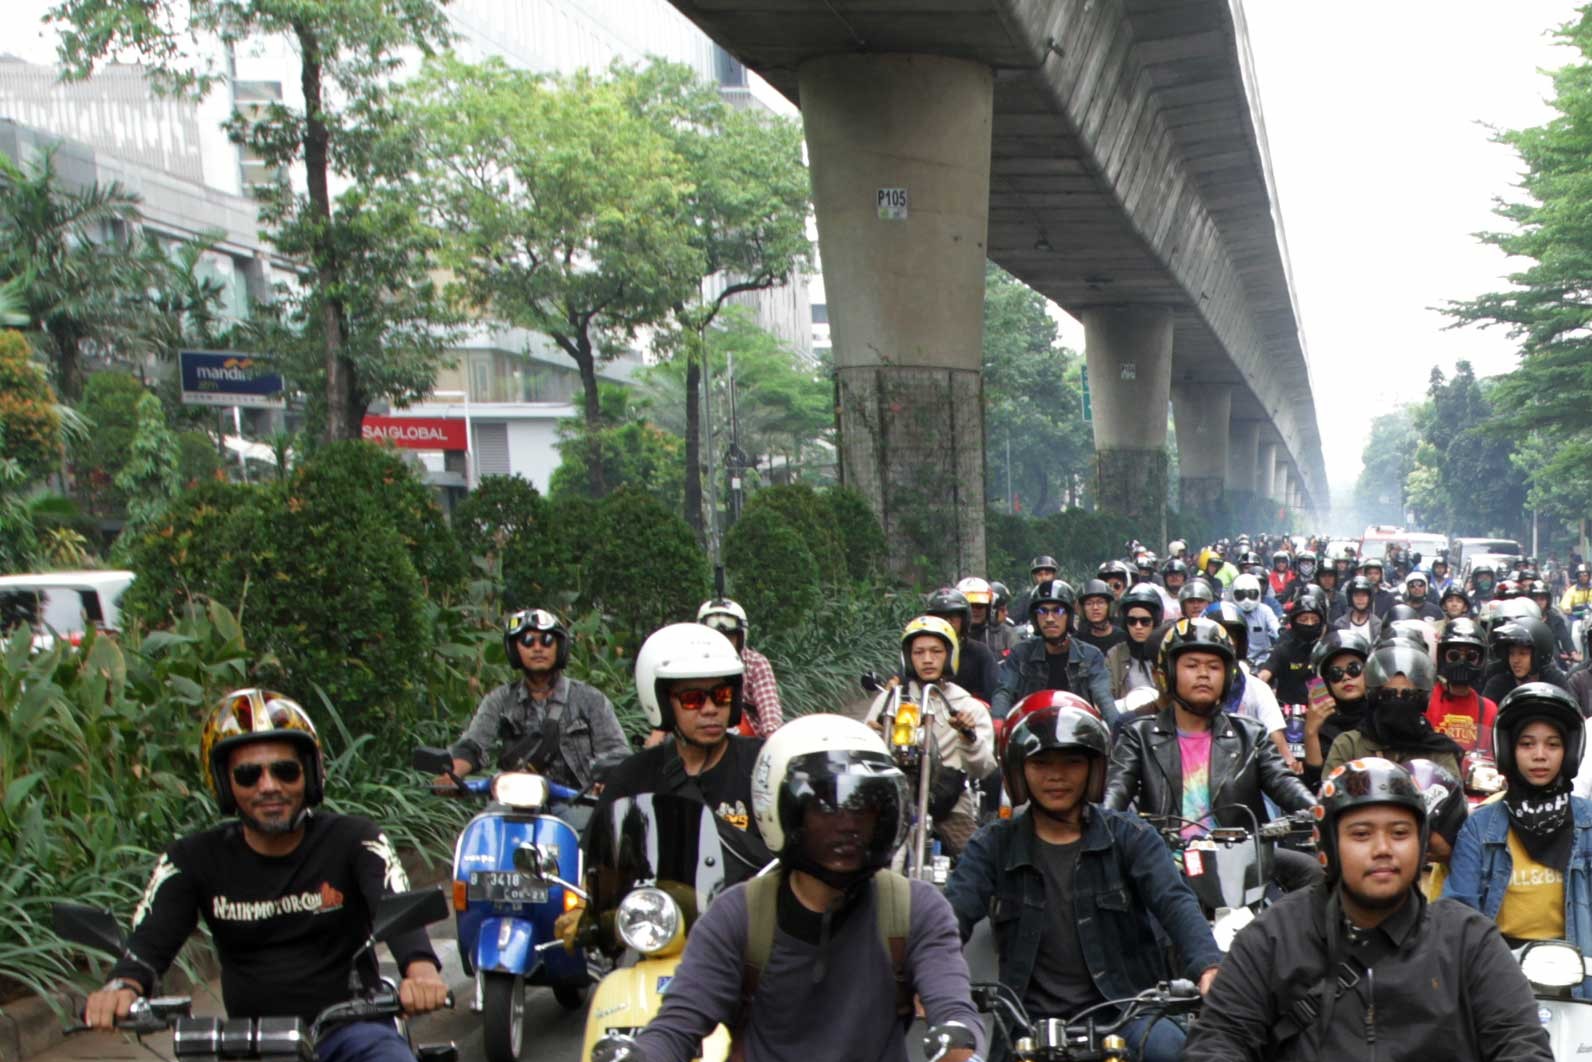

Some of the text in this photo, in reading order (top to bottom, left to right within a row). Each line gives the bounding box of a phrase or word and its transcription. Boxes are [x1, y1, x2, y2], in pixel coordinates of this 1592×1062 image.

[878, 190, 906, 206] P105
[196, 366, 254, 381] mandi
[389, 427, 448, 440] GLOBAL
